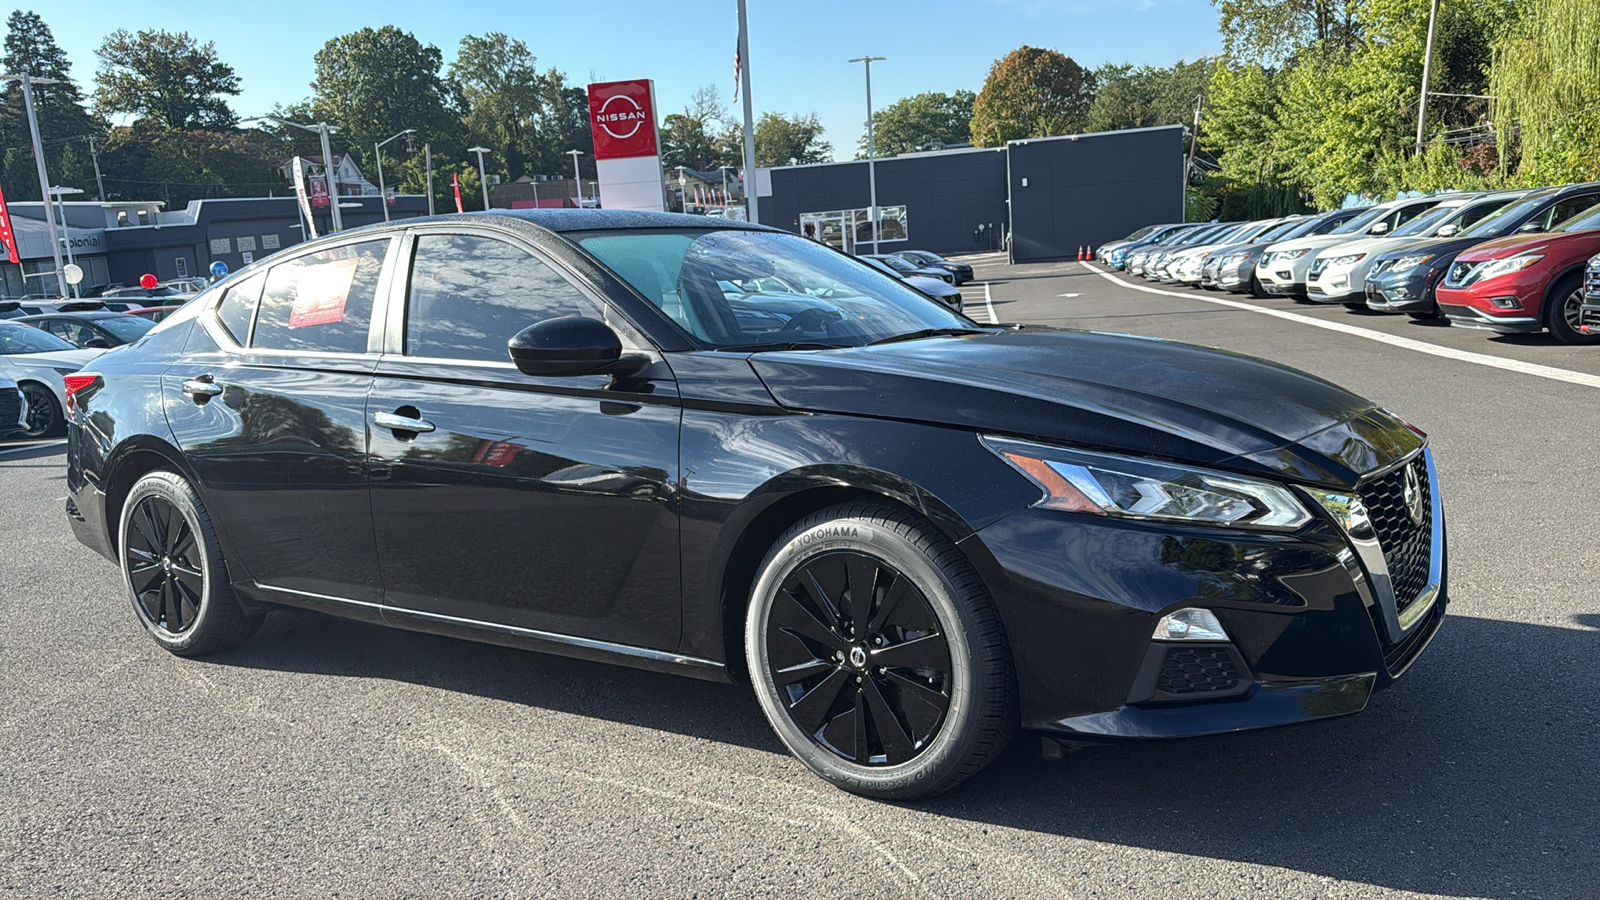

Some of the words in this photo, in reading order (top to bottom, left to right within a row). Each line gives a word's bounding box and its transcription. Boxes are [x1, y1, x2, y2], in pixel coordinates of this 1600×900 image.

[596, 111, 646, 123] NISSAN
[797, 526, 859, 547] YOKOHAMA
[840, 774, 862, 788] LX
[866, 777, 910, 791] Ascend
